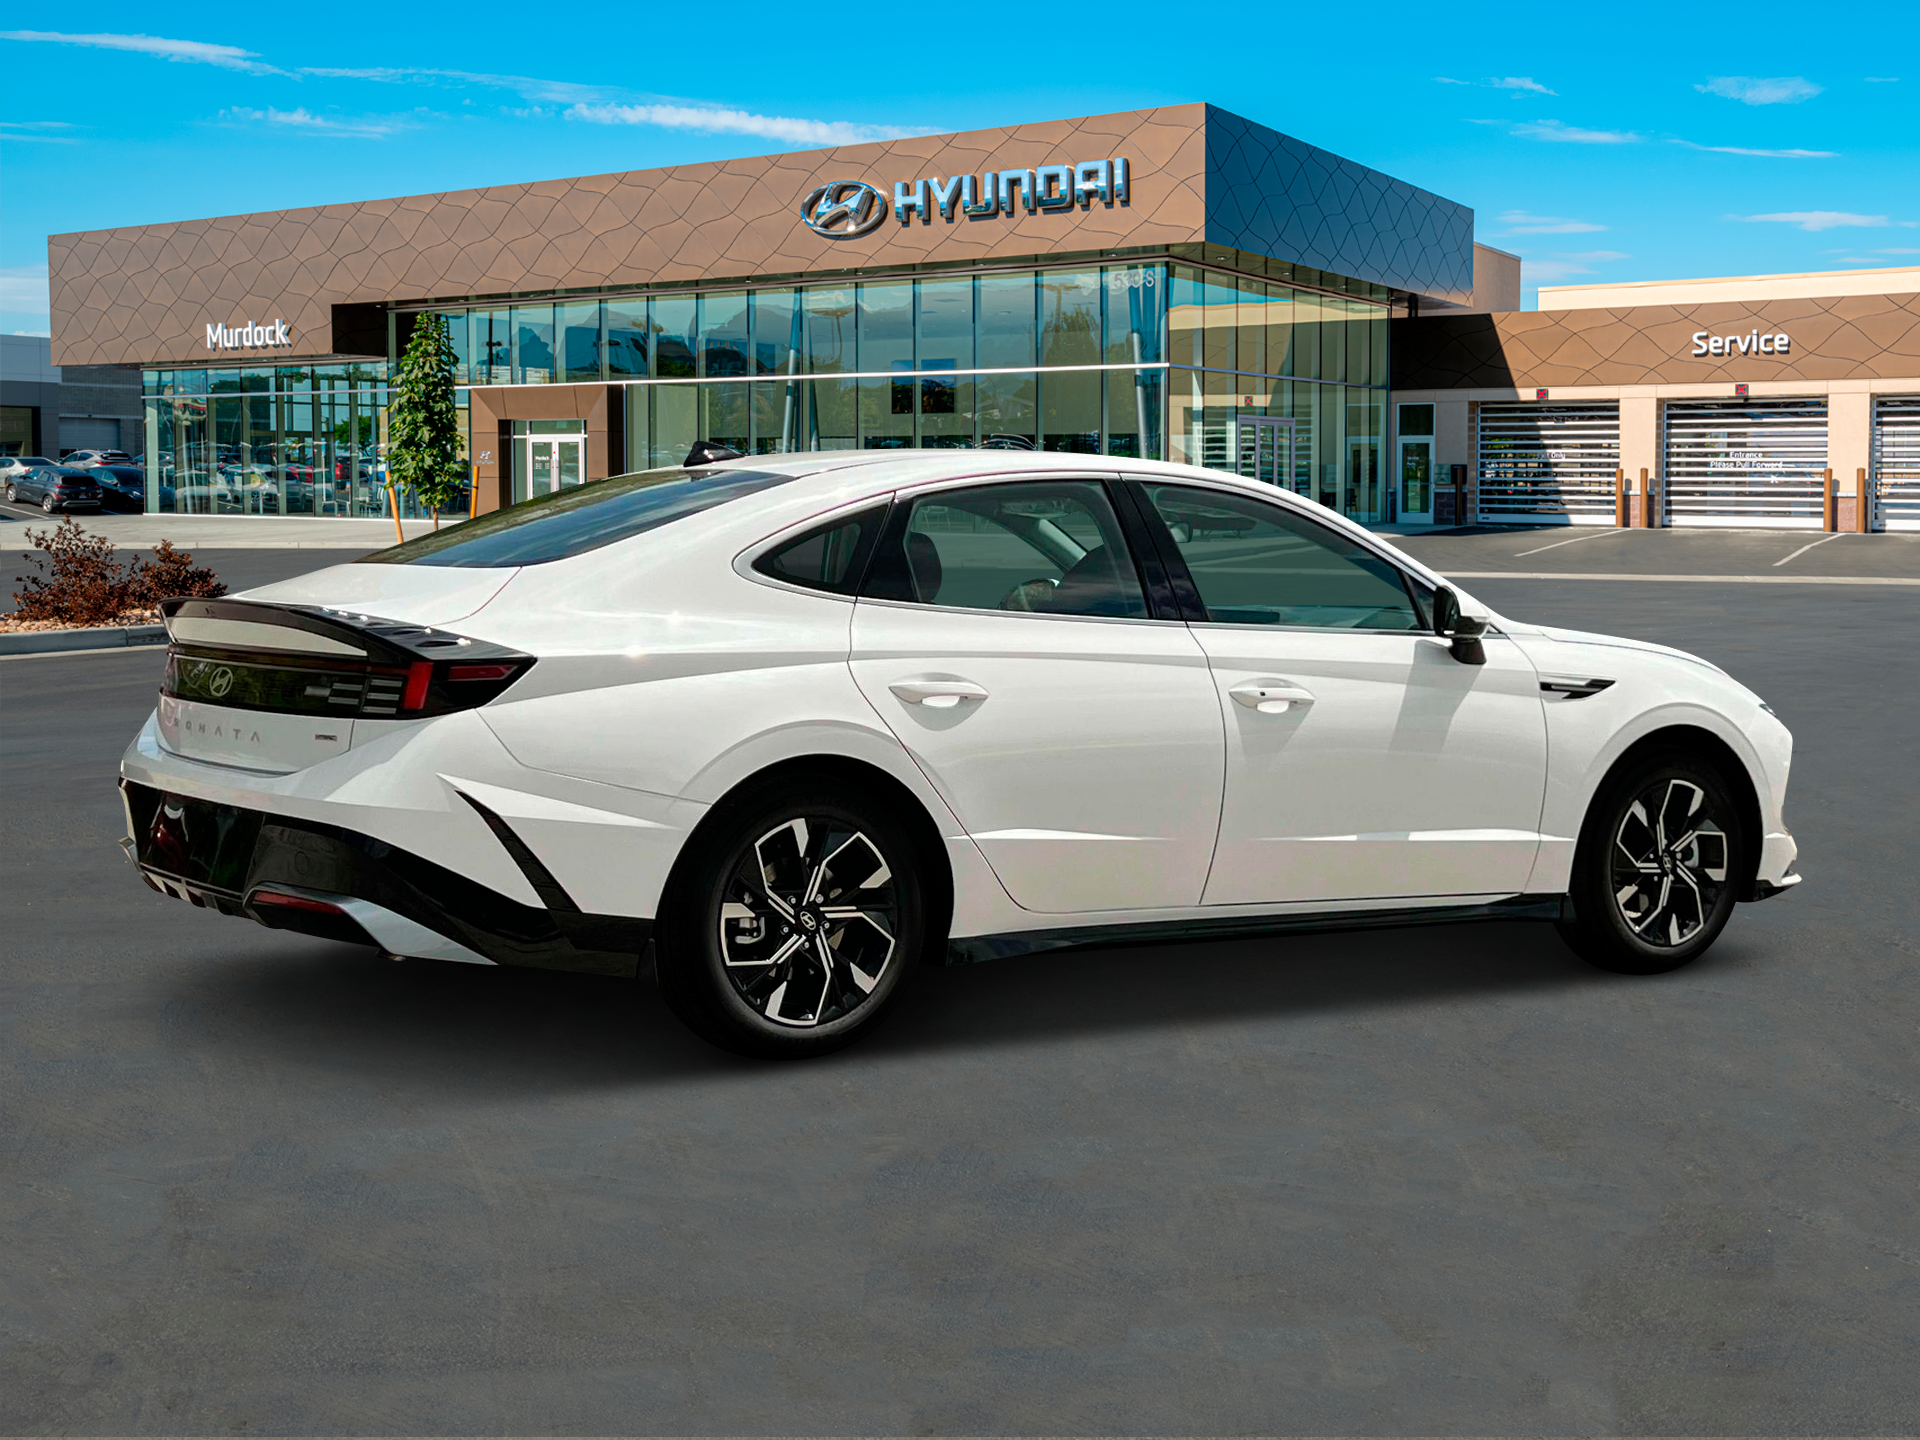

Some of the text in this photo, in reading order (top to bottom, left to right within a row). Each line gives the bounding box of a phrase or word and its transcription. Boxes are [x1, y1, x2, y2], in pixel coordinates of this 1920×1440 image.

[894, 157, 1130, 225] HYUNDAI
[1114, 270, 1155, 289] 530 S
[206, 318, 290, 349] Murdock
[1691, 329, 1790, 356] Service
[1550, 451, 1566, 460] Only
[1709, 460, 1783, 469] Please Pull Forward
[1729, 451, 1763, 459] Entrance
[174, 717, 261, 743] SONATA
